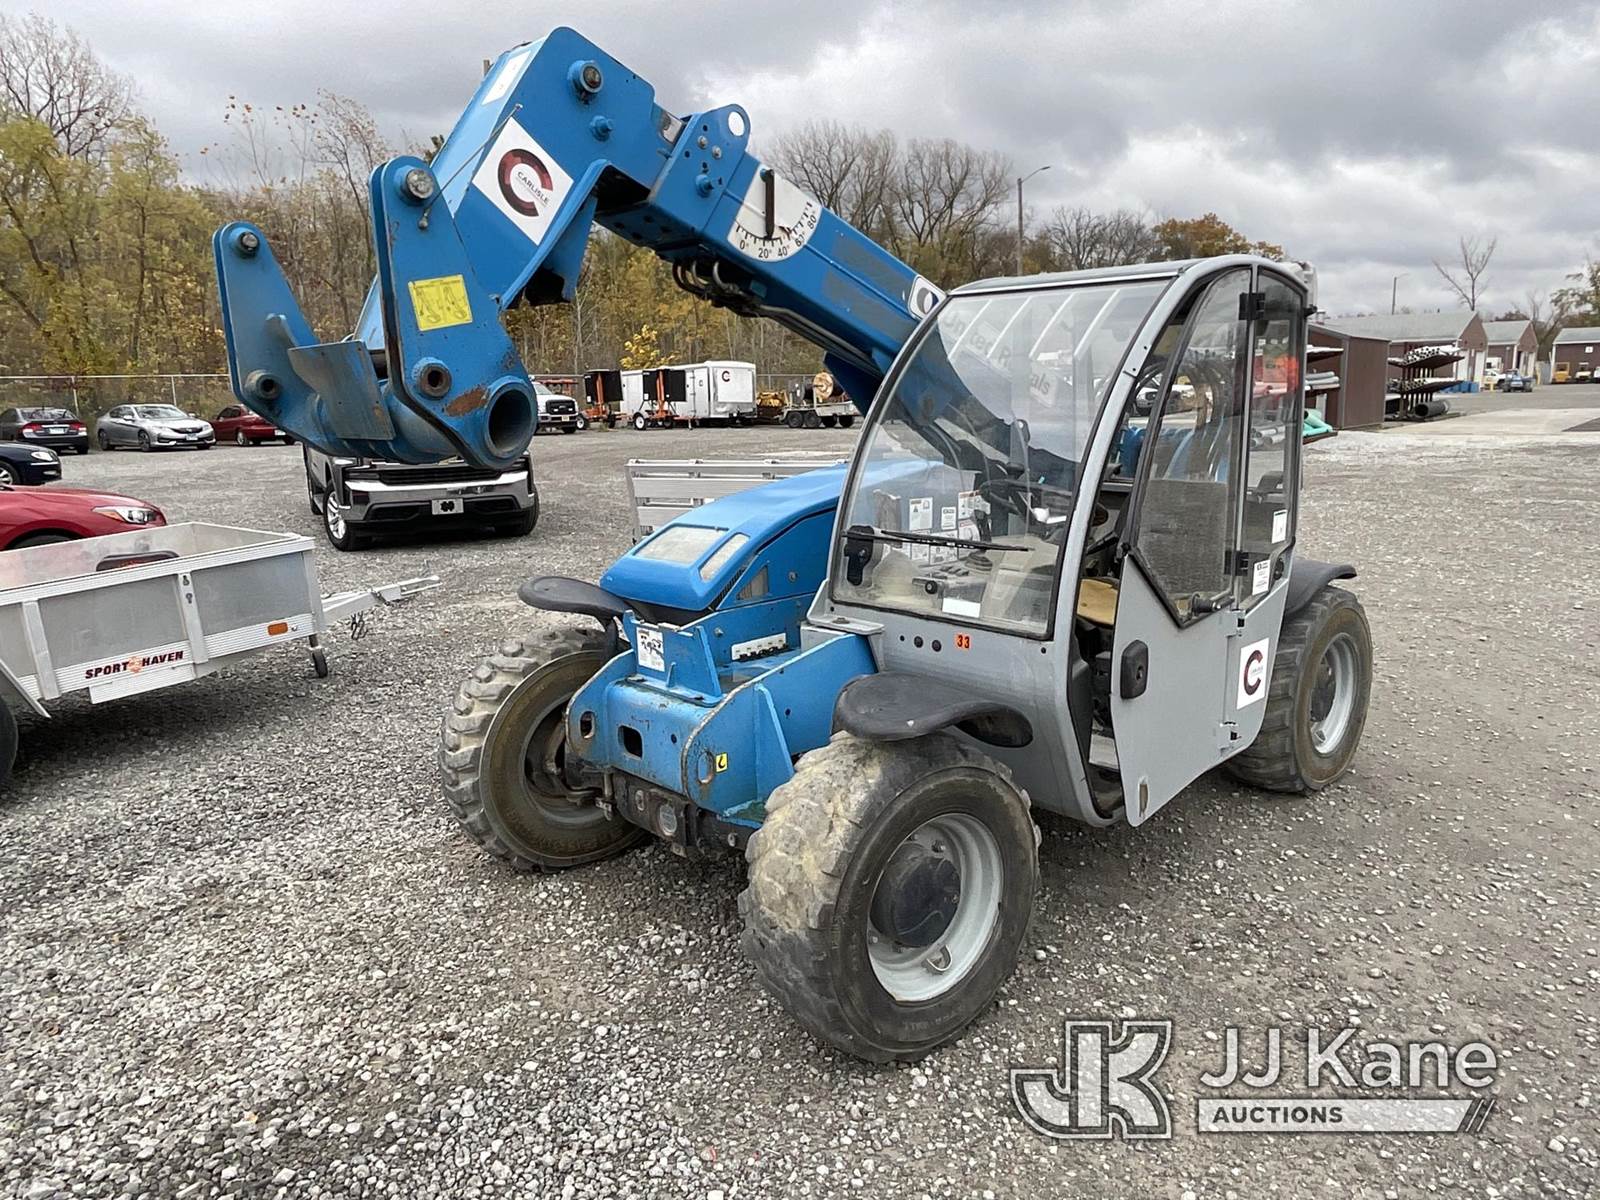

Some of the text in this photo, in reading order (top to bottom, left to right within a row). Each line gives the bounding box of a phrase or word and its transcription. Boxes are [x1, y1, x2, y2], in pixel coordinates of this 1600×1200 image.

[517, 171, 550, 205] CARLISLE
[957, 634, 970, 649] 33
[85, 650, 184, 679] SPORT HAVEN
